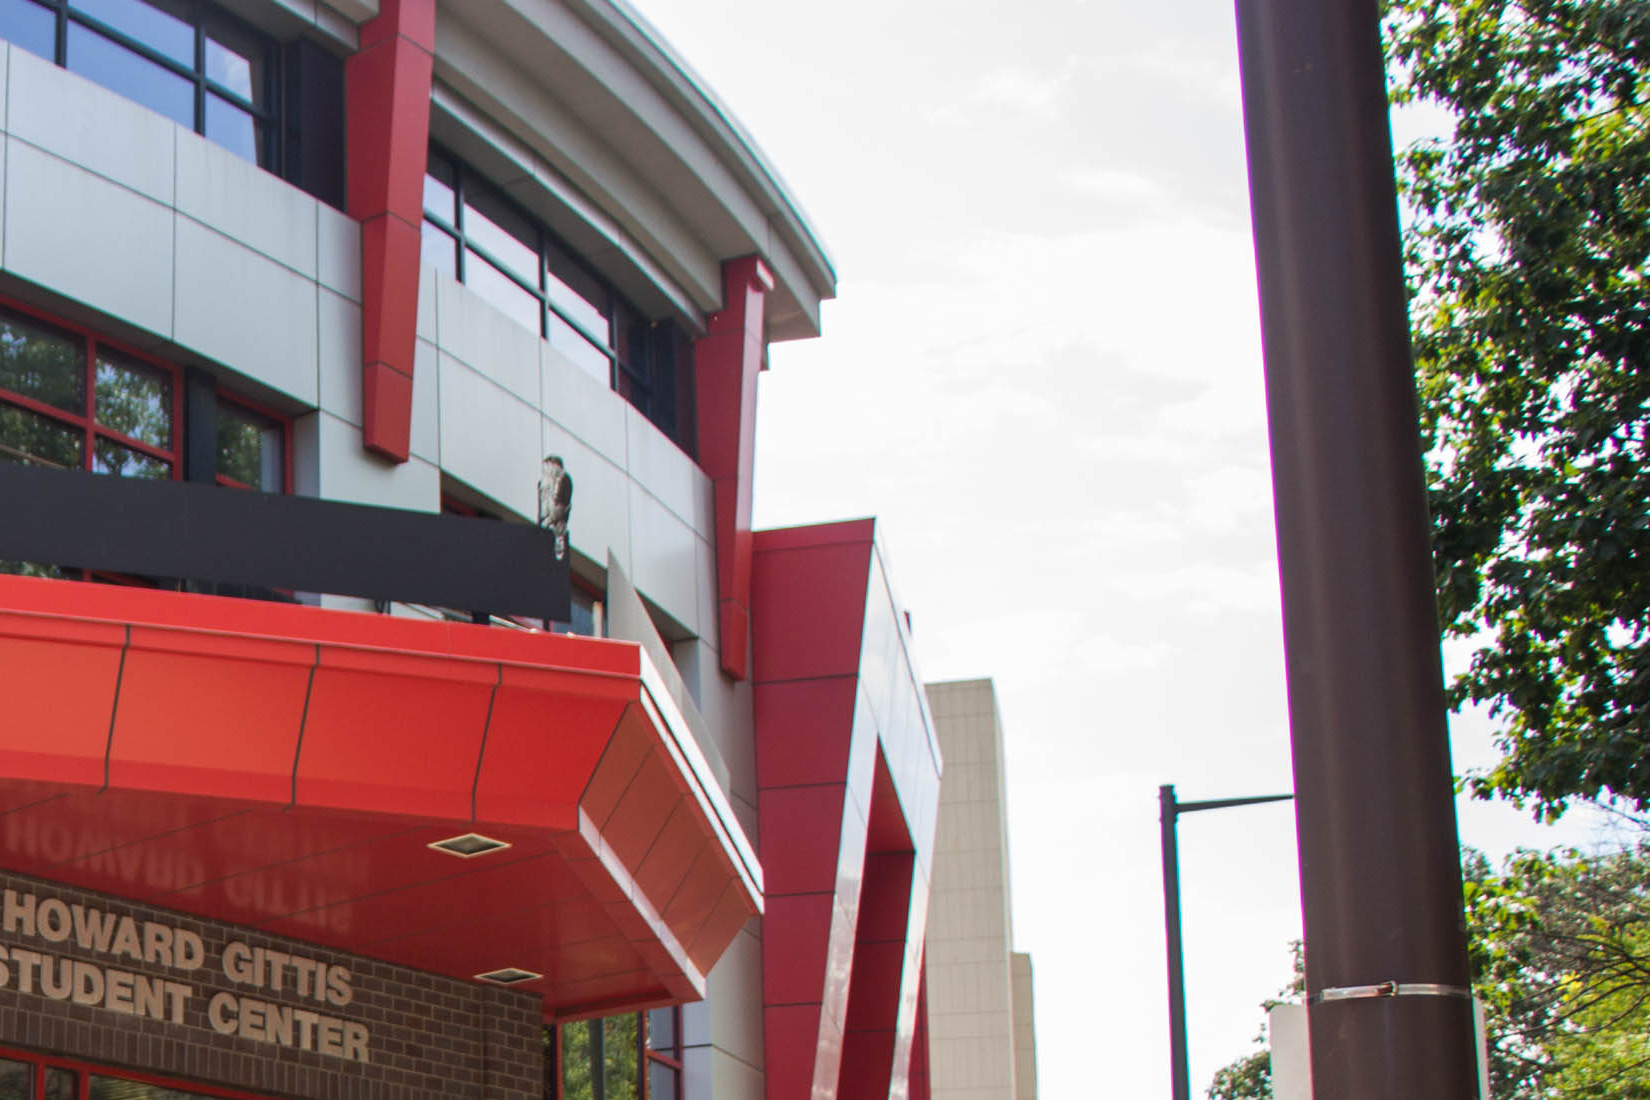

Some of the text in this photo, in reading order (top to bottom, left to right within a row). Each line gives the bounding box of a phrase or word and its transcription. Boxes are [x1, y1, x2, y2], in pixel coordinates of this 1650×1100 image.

[2, 889, 353, 1006] HOWARD GITTIS
[208, 992, 369, 1063] CENTER
